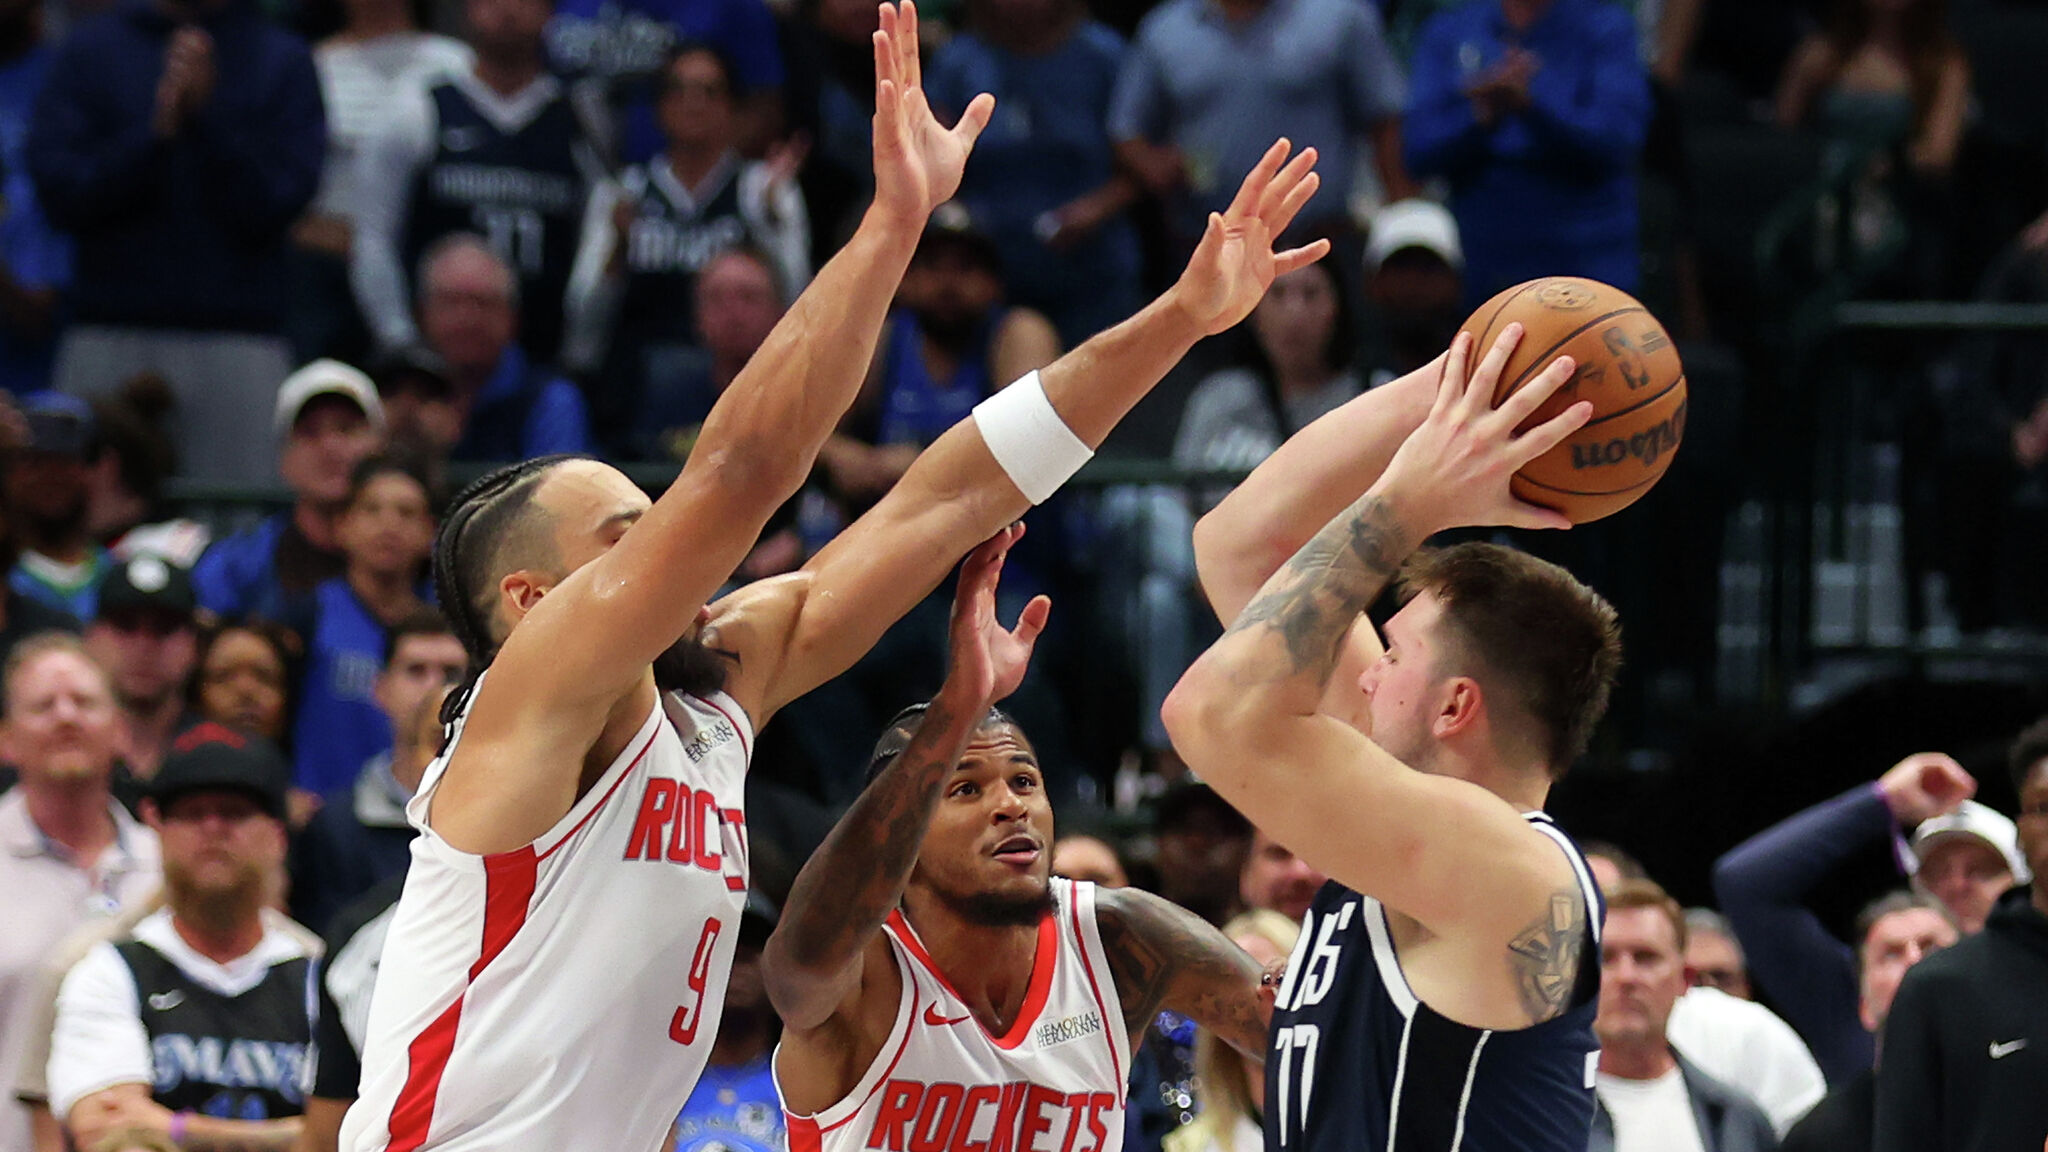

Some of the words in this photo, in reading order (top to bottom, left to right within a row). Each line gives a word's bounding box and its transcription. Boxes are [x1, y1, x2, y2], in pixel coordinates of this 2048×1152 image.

[668, 916, 722, 1046] 9
[1035, 1011, 1099, 1039] MEMORIAL
[1038, 1019, 1101, 1048] HERMANN
[866, 1078, 1116, 1152] ROCKETS
[1275, 1023, 1320, 1147] 77
